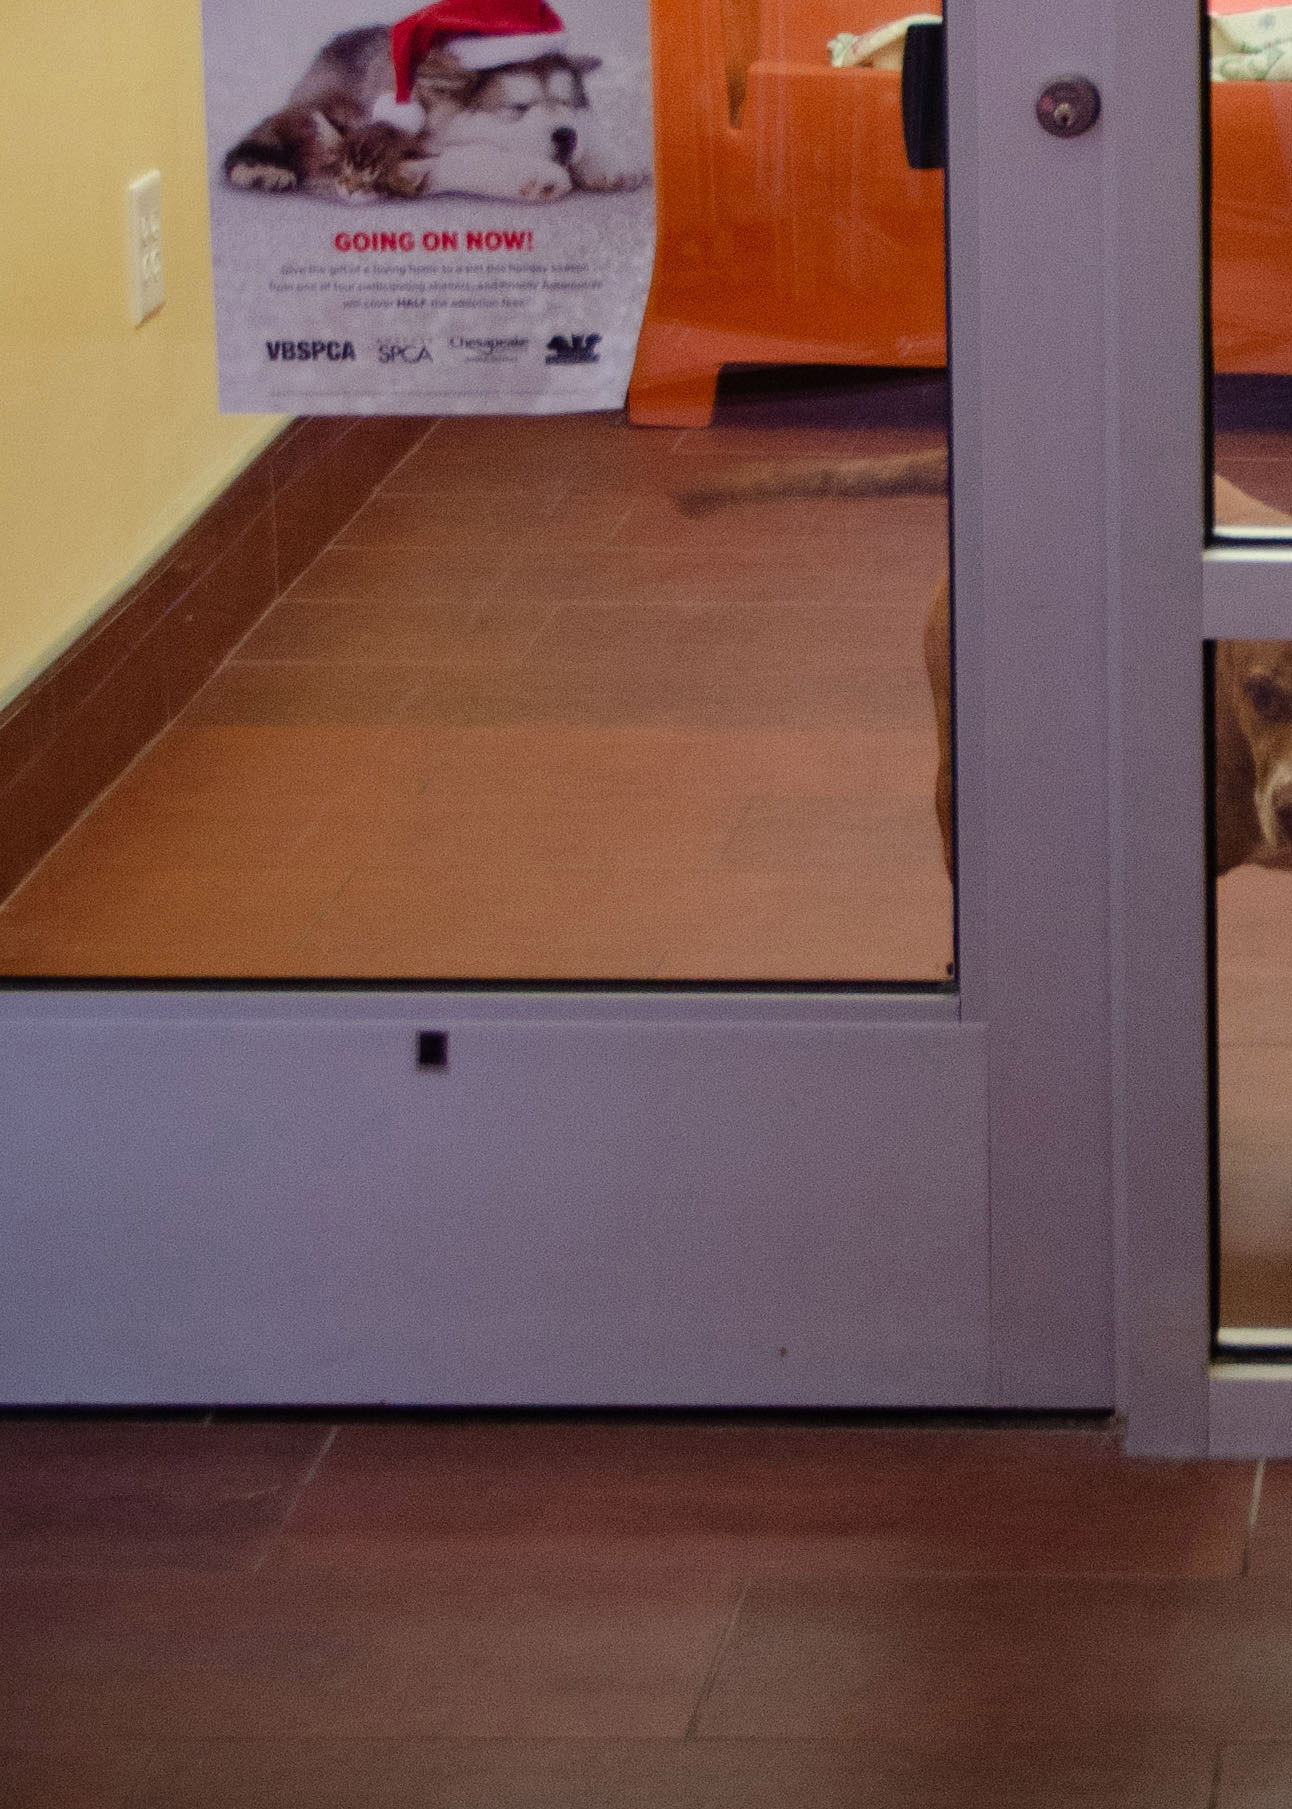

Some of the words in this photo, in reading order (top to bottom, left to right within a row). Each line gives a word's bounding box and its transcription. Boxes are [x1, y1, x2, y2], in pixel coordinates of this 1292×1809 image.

[334, 231, 415, 252] GOING
[422, 231, 458, 252] ON
[466, 230, 533, 252] NOW!
[266, 340, 357, 362] VBSPCA
[377, 344, 433, 364] SPCA
